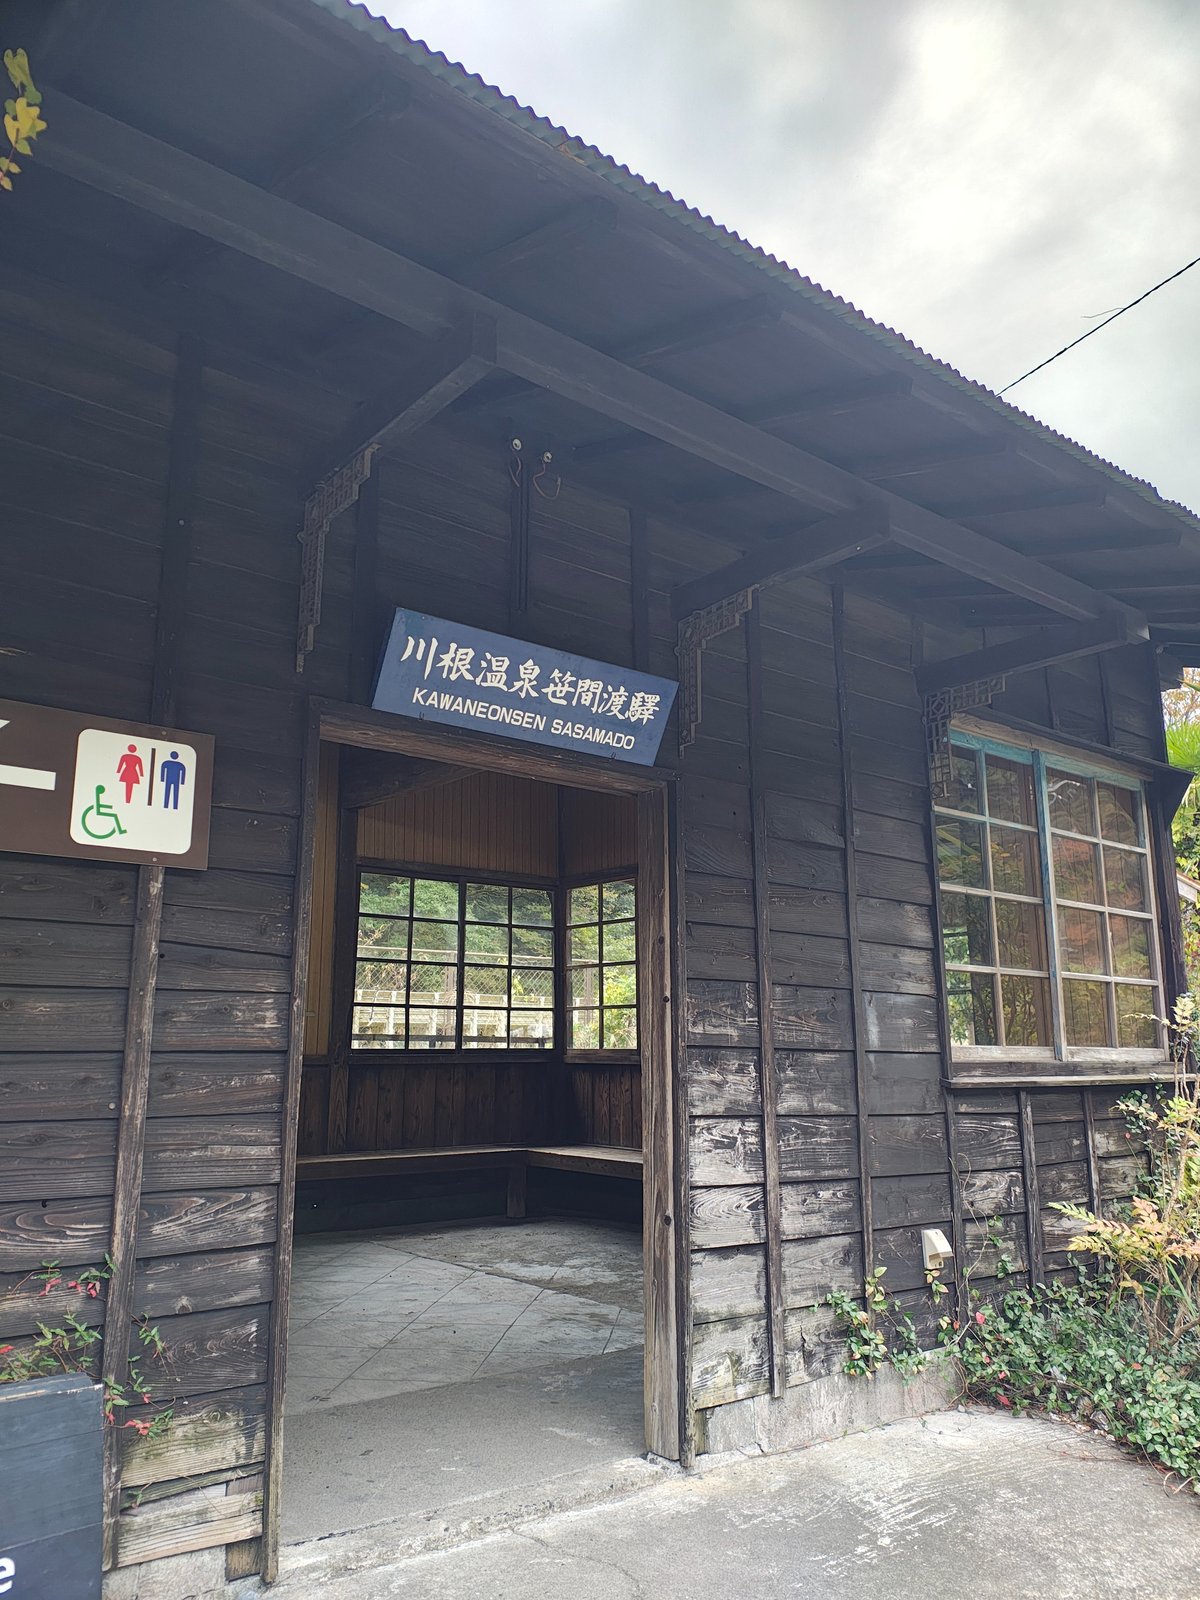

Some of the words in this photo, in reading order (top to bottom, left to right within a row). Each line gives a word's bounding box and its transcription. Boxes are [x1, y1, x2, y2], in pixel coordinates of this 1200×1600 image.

[400, 636, 660, 726] 川根温泉笹間渡驛
[412, 687, 546, 731] KAWANEONSEN
[551, 719, 635, 750] SASAMADO
